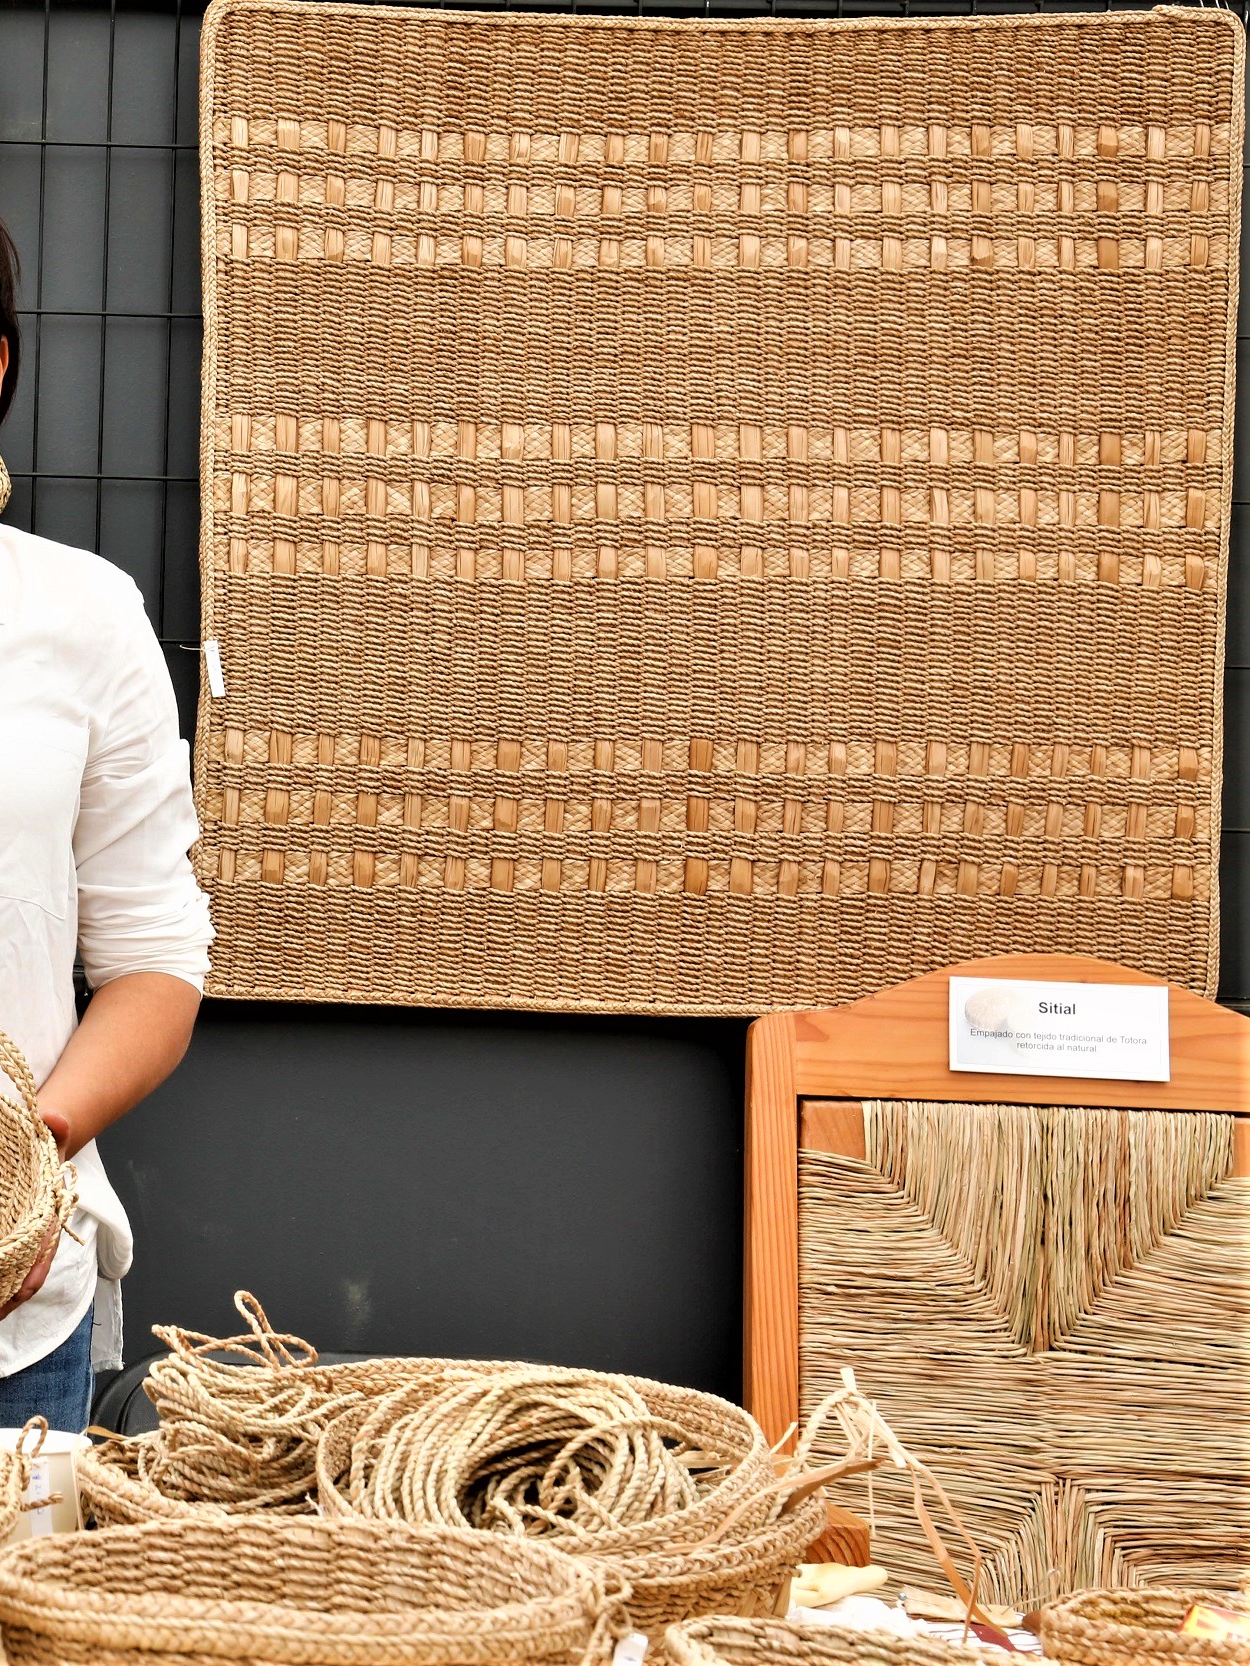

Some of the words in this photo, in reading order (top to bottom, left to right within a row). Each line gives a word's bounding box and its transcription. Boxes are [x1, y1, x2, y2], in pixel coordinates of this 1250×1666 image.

[1038, 1001, 1077, 1015] Sitial
[970, 1028, 1014, 1039] Empajado
[1033, 1032, 1057, 1042] tejido
[1059, 1033, 1104, 1043] tradicional
[1106, 1035, 1118, 1043] de
[1120, 1036, 1147, 1045] Totora
[1016, 1041, 1054, 1051] retorcida
[1056, 1043, 1065, 1051] al
[1067, 1043, 1097, 1053] natural
